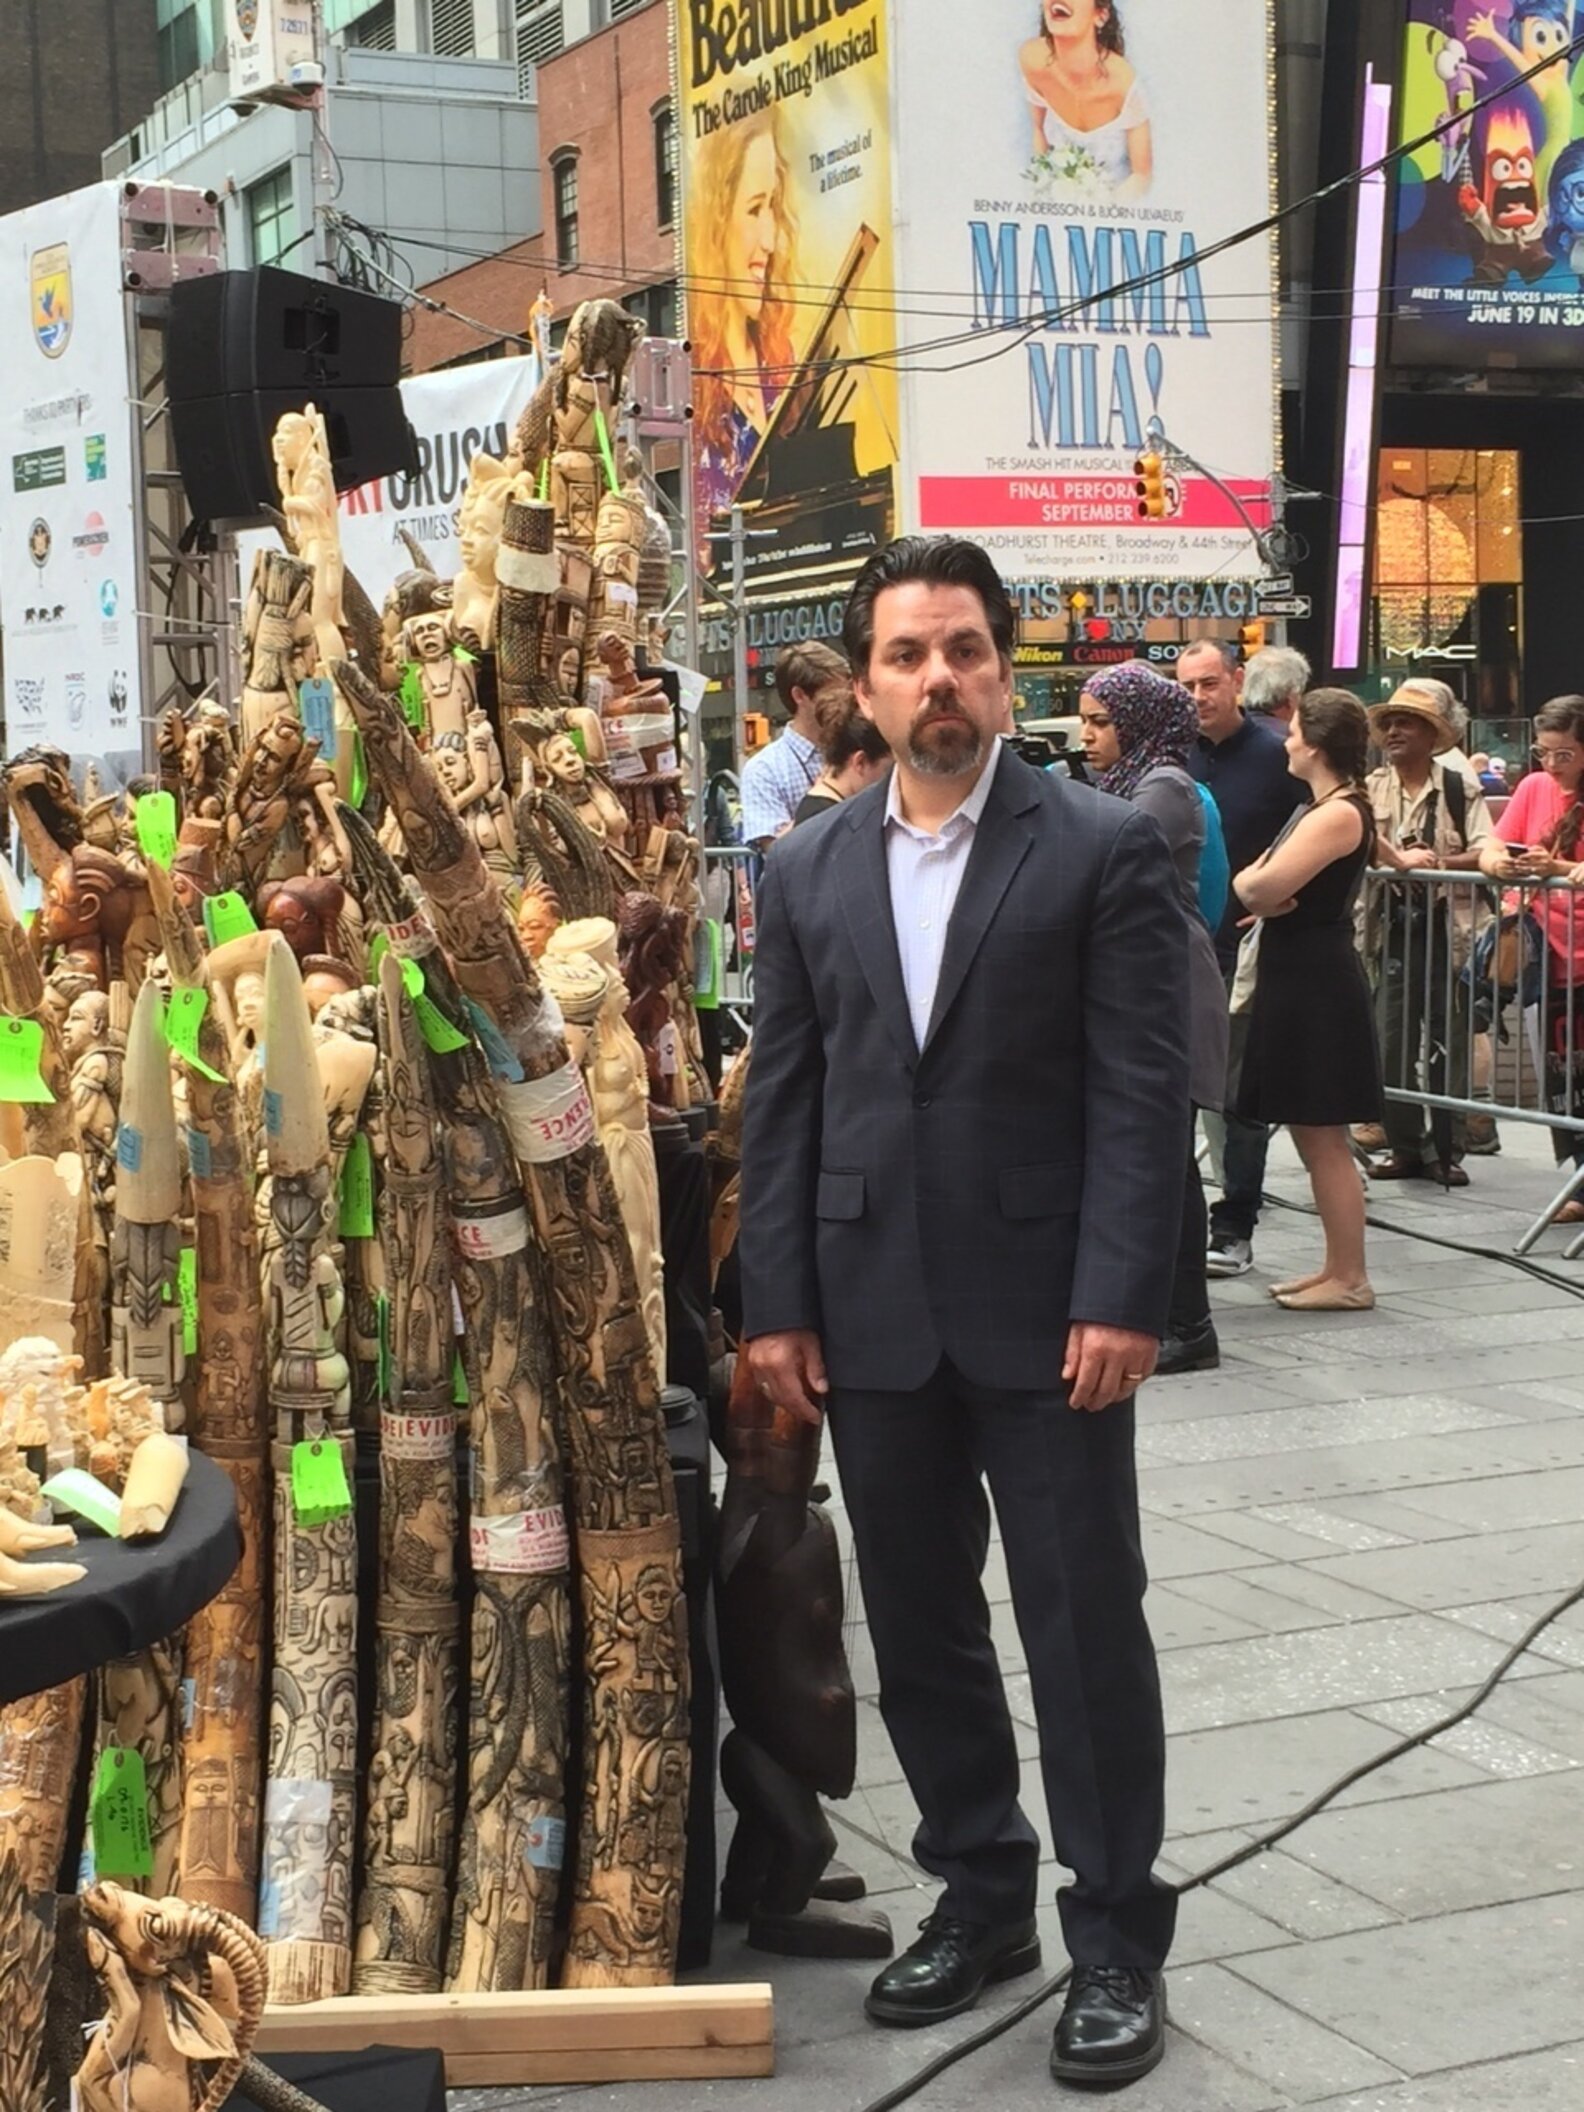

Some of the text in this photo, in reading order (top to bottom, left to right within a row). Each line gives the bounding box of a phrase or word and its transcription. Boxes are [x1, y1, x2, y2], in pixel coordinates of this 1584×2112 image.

[692, 14, 879, 139] The Carole King Musical
[809, 128, 872, 173] The musical of
[820, 178, 826, 193] a
[974, 199, 1013, 213] BENNY
[1016, 202, 1085, 217] ANDERSSON
[1087, 205, 1096, 217] &
[968, 220, 1211, 340] MAMMA
[1411, 287, 1441, 300] MEET
[1443, 288, 1464, 300] THE
[1466, 289, 1499, 302] LITTLE
[1502, 290, 1541, 303] VOICES
[1466, 304, 1584, 327] JUNE 19 IN 3D
[1024, 341, 1166, 450] MIA!
[986, 457, 1008, 470] THE
[1010, 457, 1051, 471] SMASH
[1055, 458, 1071, 470] HIT
[1074, 458, 1123, 471] MUSICAL
[1009, 481, 1059, 500] FINAL
[1042, 504, 1134, 522] SEPTEMBER
[411, 513, 449, 542] TIMES
[1115, 534, 1175, 550] Broadway
[1178, 535, 1188, 548] &
[1191, 535, 1217, 548] 44th
[1023, 553, 1096, 567] Telecharge.com
[1107, 553, 1130, 564] 212
[1153, 553, 1180, 565] 6200
[1094, 582, 1258, 618] LUGGAG
[750, 600, 845, 648] LUGGAG
[1110, 619, 1148, 643] NY
[1012, 645, 1063, 663] Nikon
[1073, 645, 1138, 662] Canon
